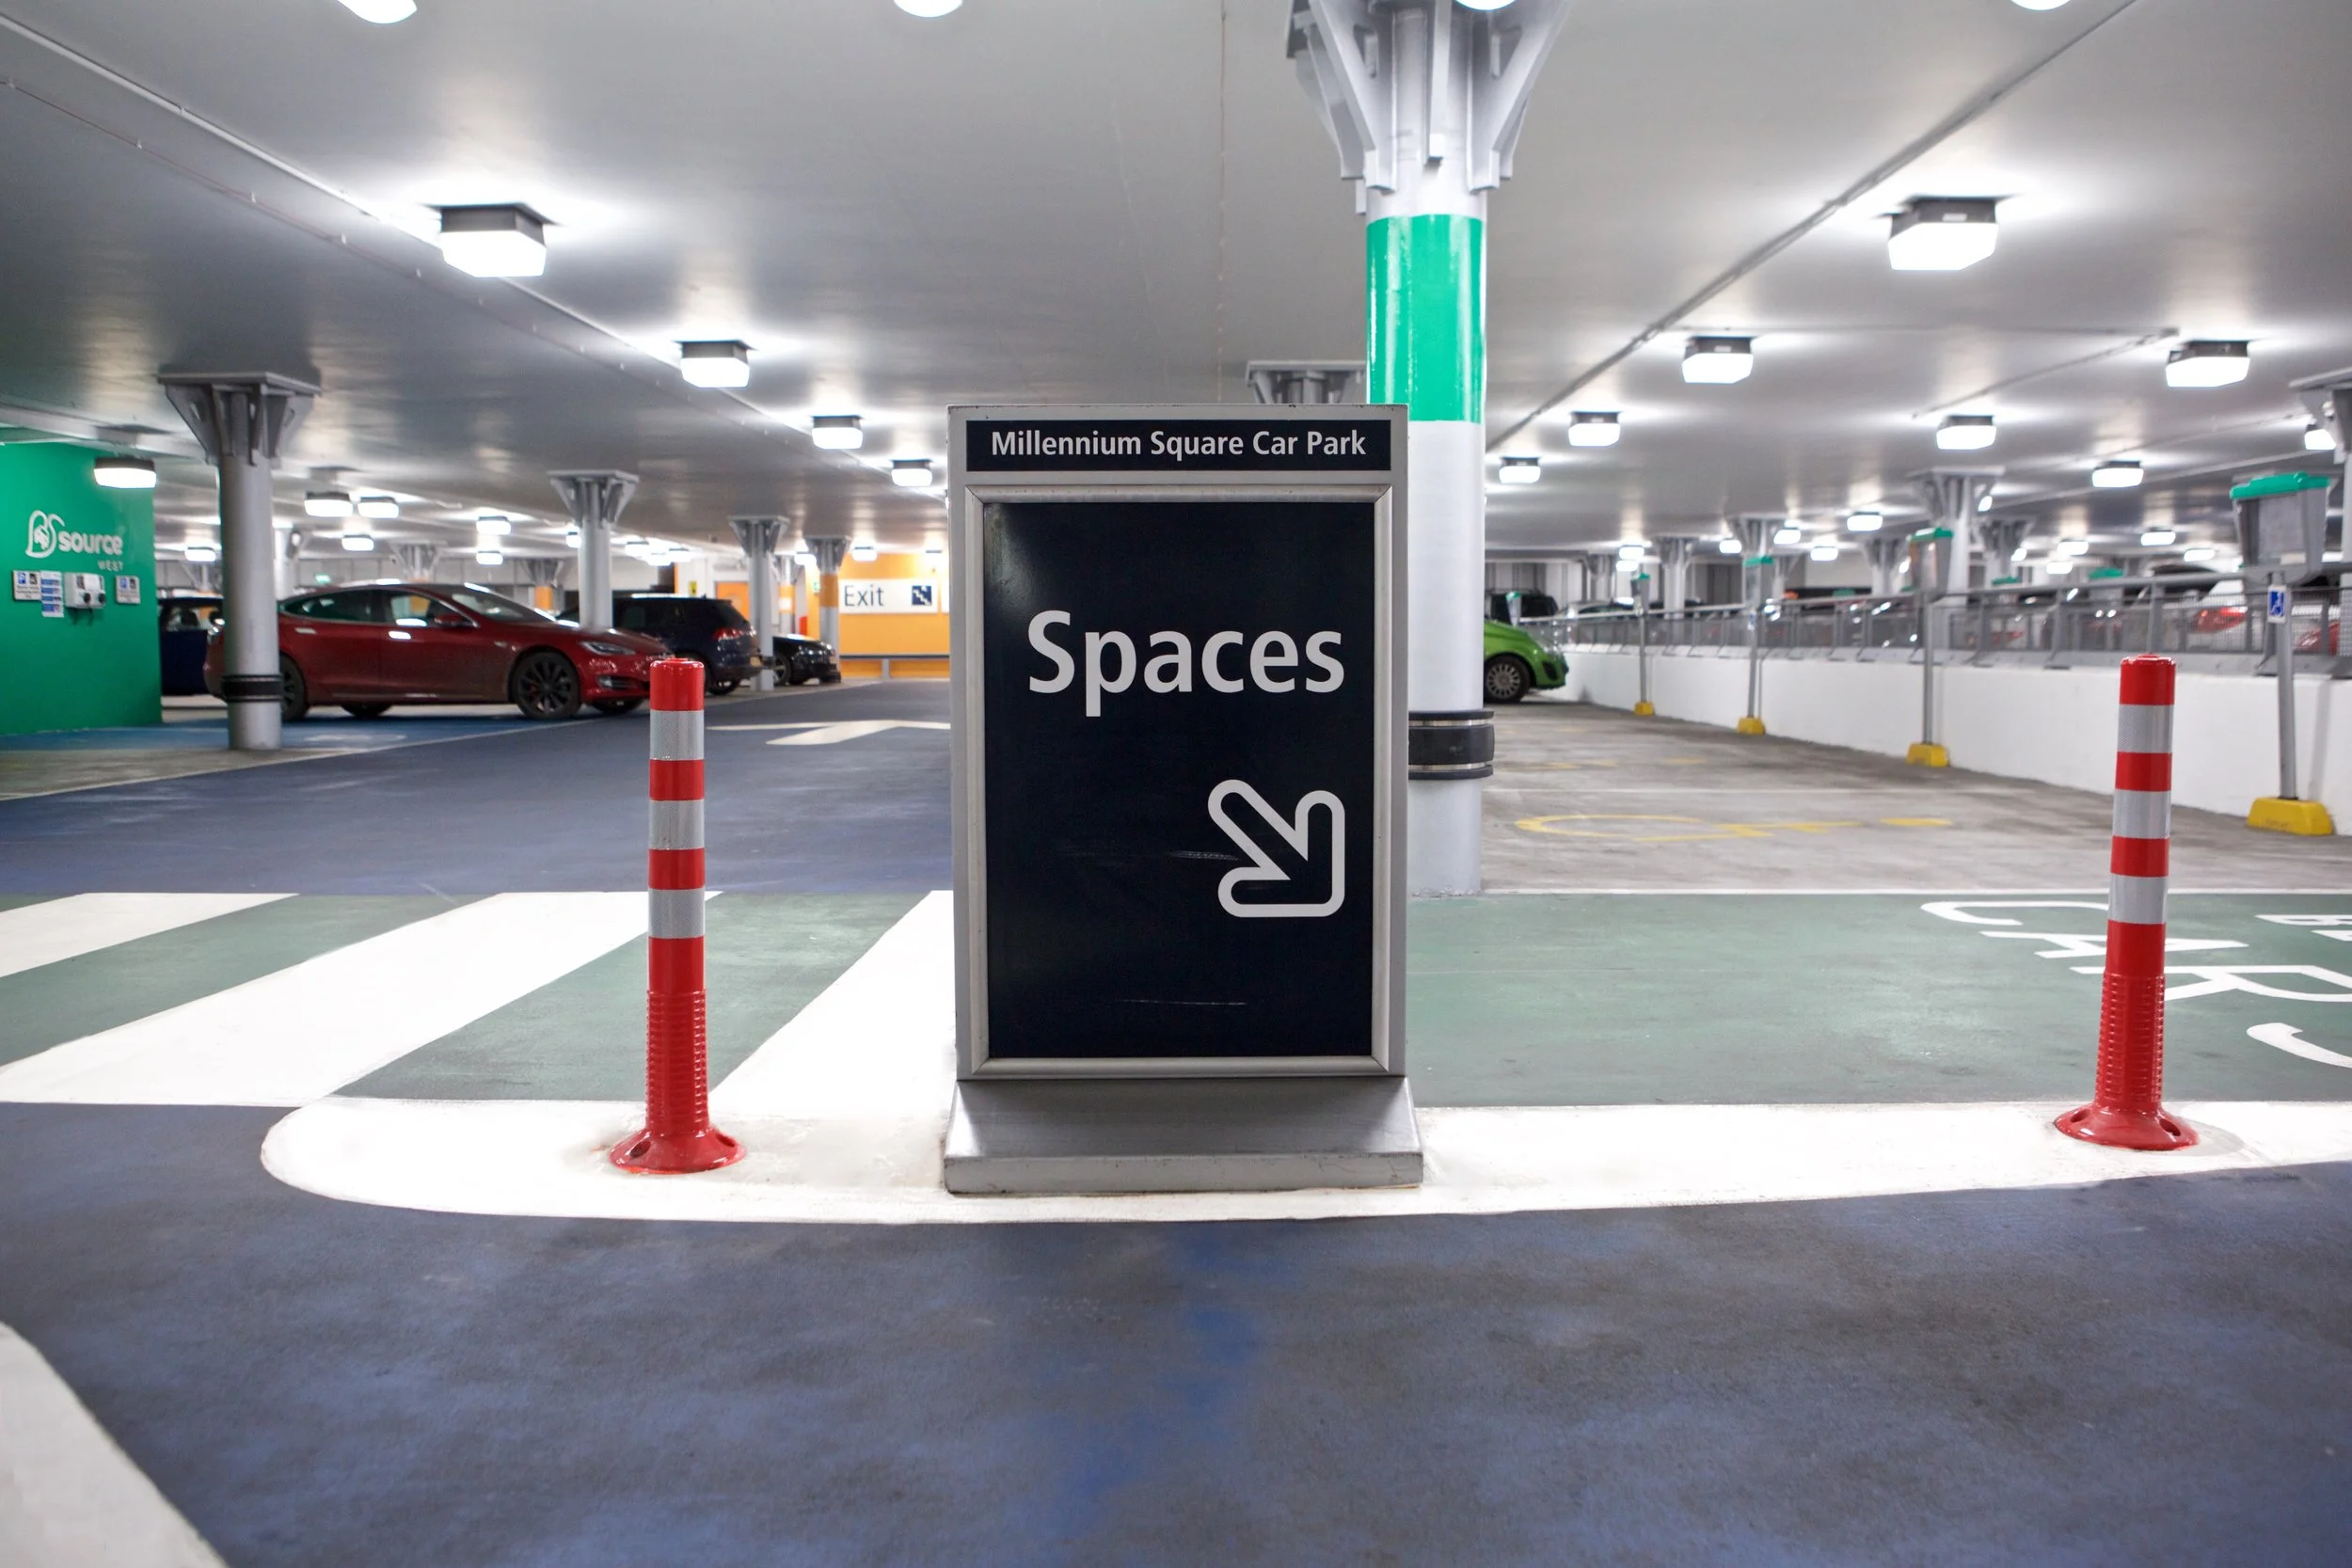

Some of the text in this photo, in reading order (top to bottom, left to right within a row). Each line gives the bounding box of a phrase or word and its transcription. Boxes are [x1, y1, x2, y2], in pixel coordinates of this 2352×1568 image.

[991, 429, 1367, 462] Millennium Square Car Park
[57, 531, 123, 556] source
[97, 559, 124, 572] WEST
[844, 584, 884, 607] Exit
[1026, 610, 1346, 718] Spaces
